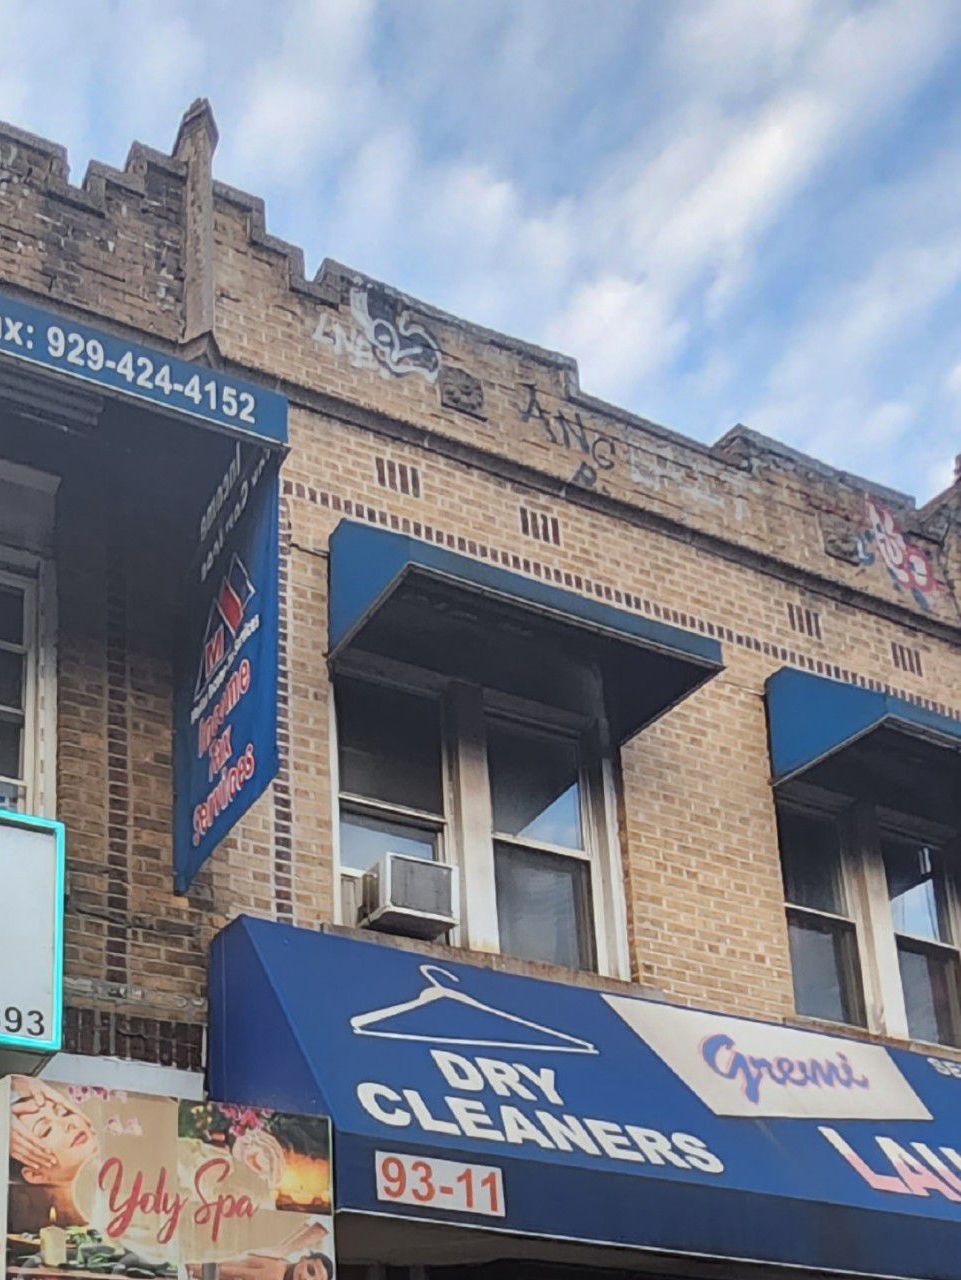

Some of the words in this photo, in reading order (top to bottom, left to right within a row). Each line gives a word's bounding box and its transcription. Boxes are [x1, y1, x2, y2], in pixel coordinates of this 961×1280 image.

[46, 326, 257, 425] 929-424-4152
[430, 1048, 562, 1107] DRY
[355, 1080, 725, 1175] CLEANERS
[194, 1157, 259, 1243] Spa
[380, 1156, 501, 1214] 93-11
